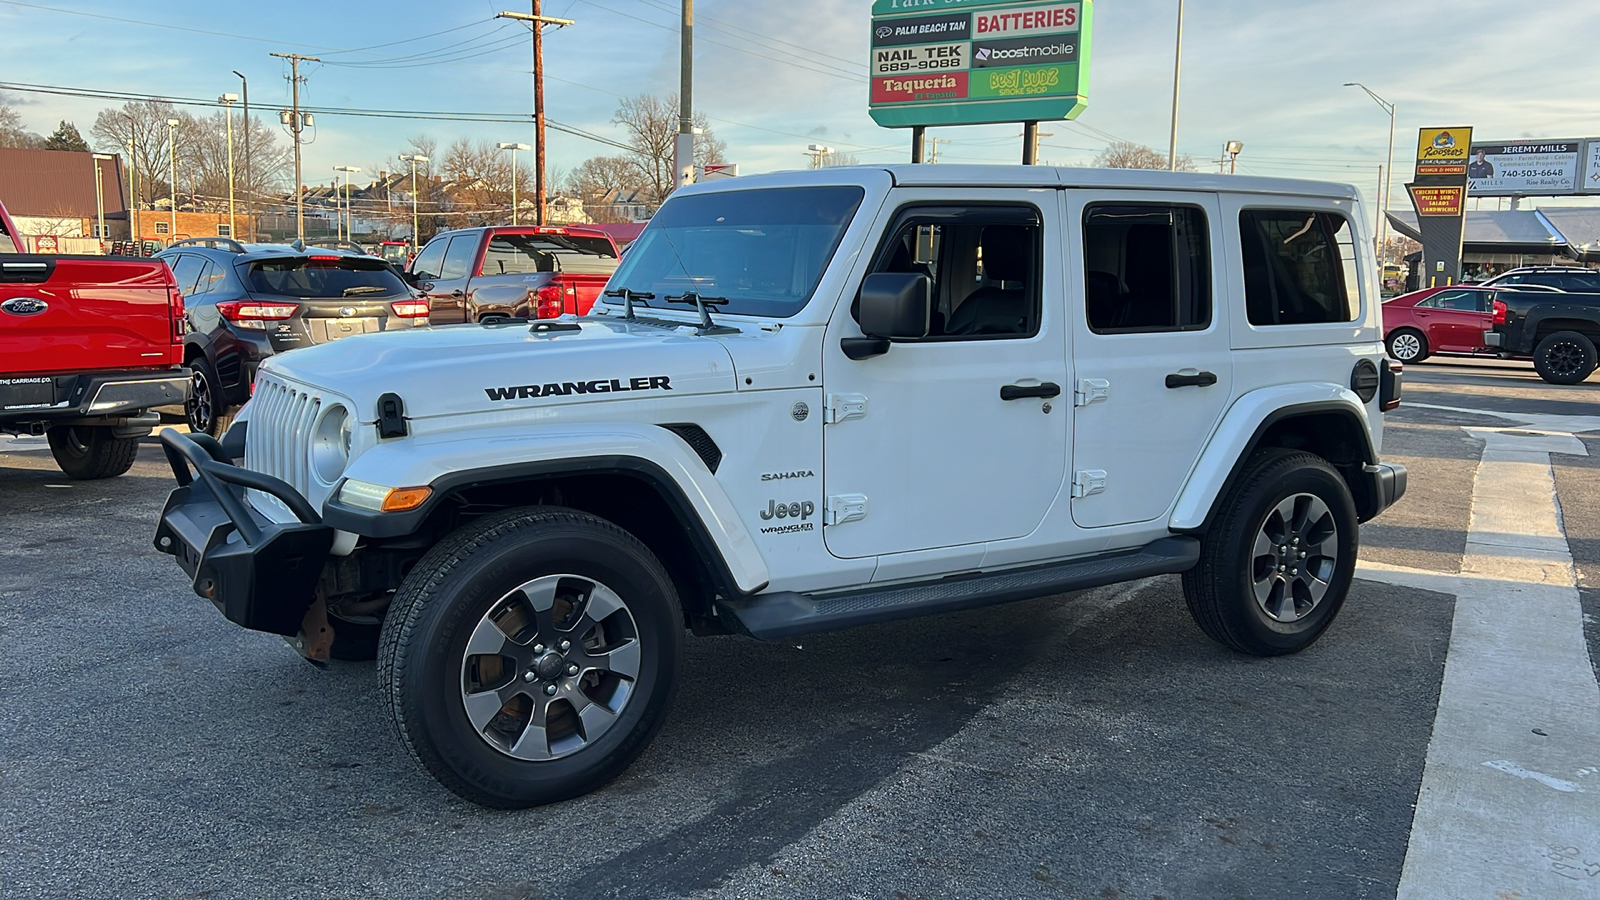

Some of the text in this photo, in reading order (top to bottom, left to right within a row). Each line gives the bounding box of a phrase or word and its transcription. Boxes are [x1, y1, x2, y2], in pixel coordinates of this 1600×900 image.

[977, 8, 1076, 33] BATTERIES
[895, 20, 966, 36] PALM BEACH TAN
[878, 45, 961, 62] NAIL TEK
[879, 58, 960, 72] 689-9088
[999, 86, 1047, 96] SMOKE SHOP
[1423, 146, 1464, 158] Roosters
[1502, 144, 1567, 153] JEREMY MILLS
[1501, 169, 1564, 178] 740-503-6648
[1540, 178, 1559, 187] Realty
[12, 300, 38, 312] Ford
[484, 375, 674, 402] WRANGLER
[760, 470, 815, 482] SAHARA
[760, 499, 815, 521] Jeep
[760, 523, 813, 534] WRANGLER
